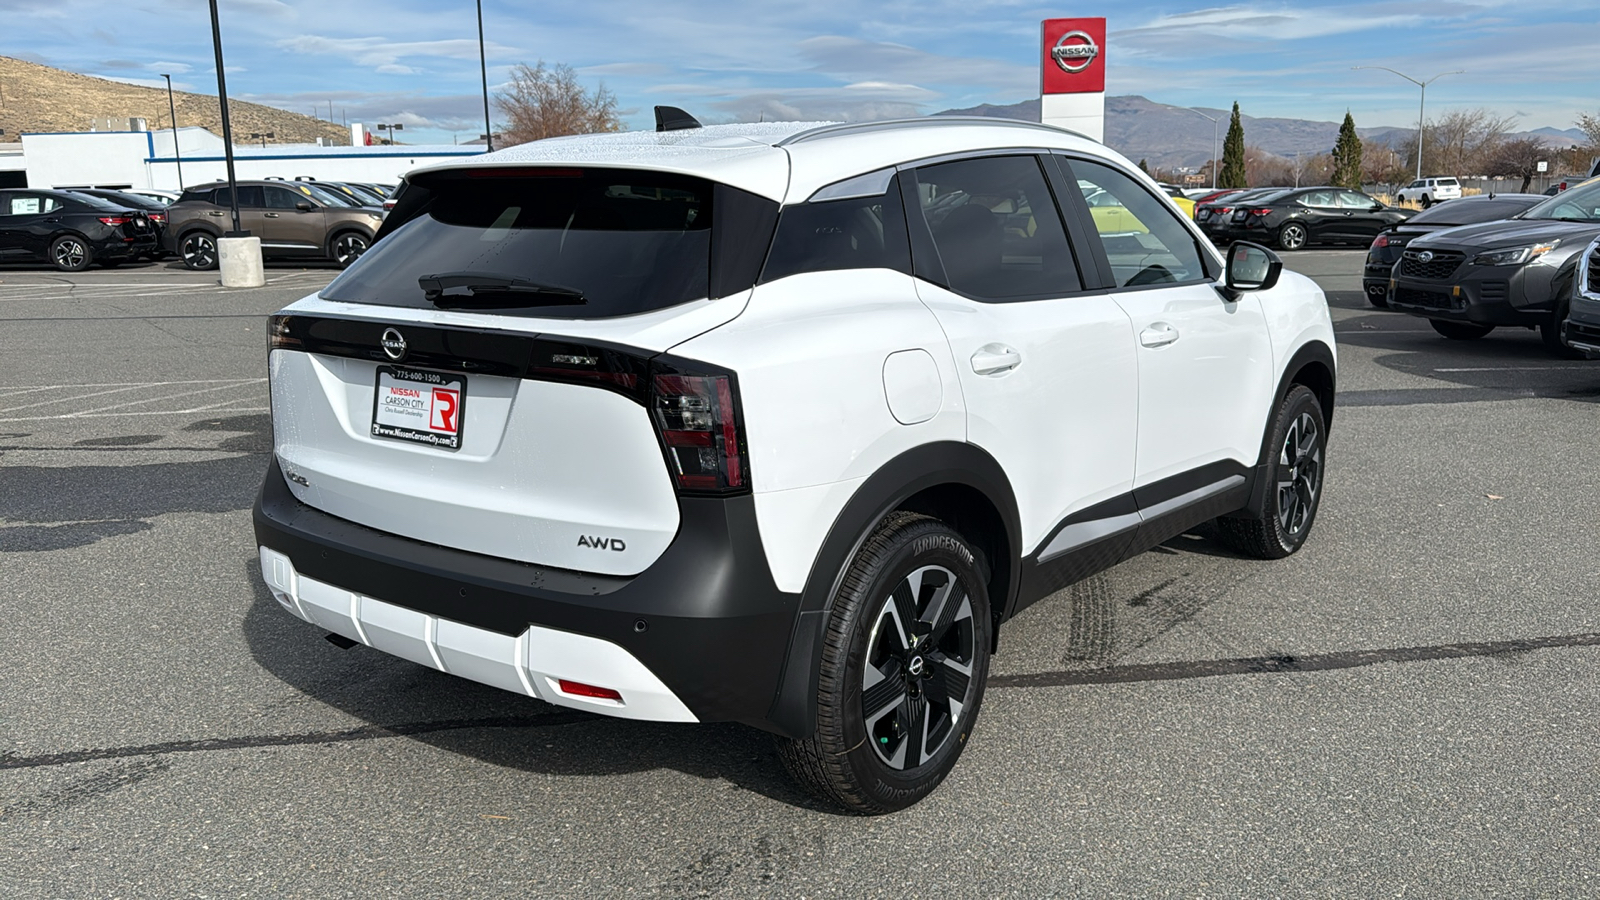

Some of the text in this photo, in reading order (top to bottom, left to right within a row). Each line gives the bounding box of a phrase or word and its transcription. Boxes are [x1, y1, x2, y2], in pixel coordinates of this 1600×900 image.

[1057, 47, 1095, 55] NISSAN
[397, 371, 440, 382] 775-600-1500
[390, 387, 420, 398] NISSAN
[385, 396, 425, 409] CARSON CITY
[380, 428, 450, 445] www.NissanCarsonCity.com
[577, 534, 626, 552] AWD
[912, 535, 975, 567] BRIDGESTONE
